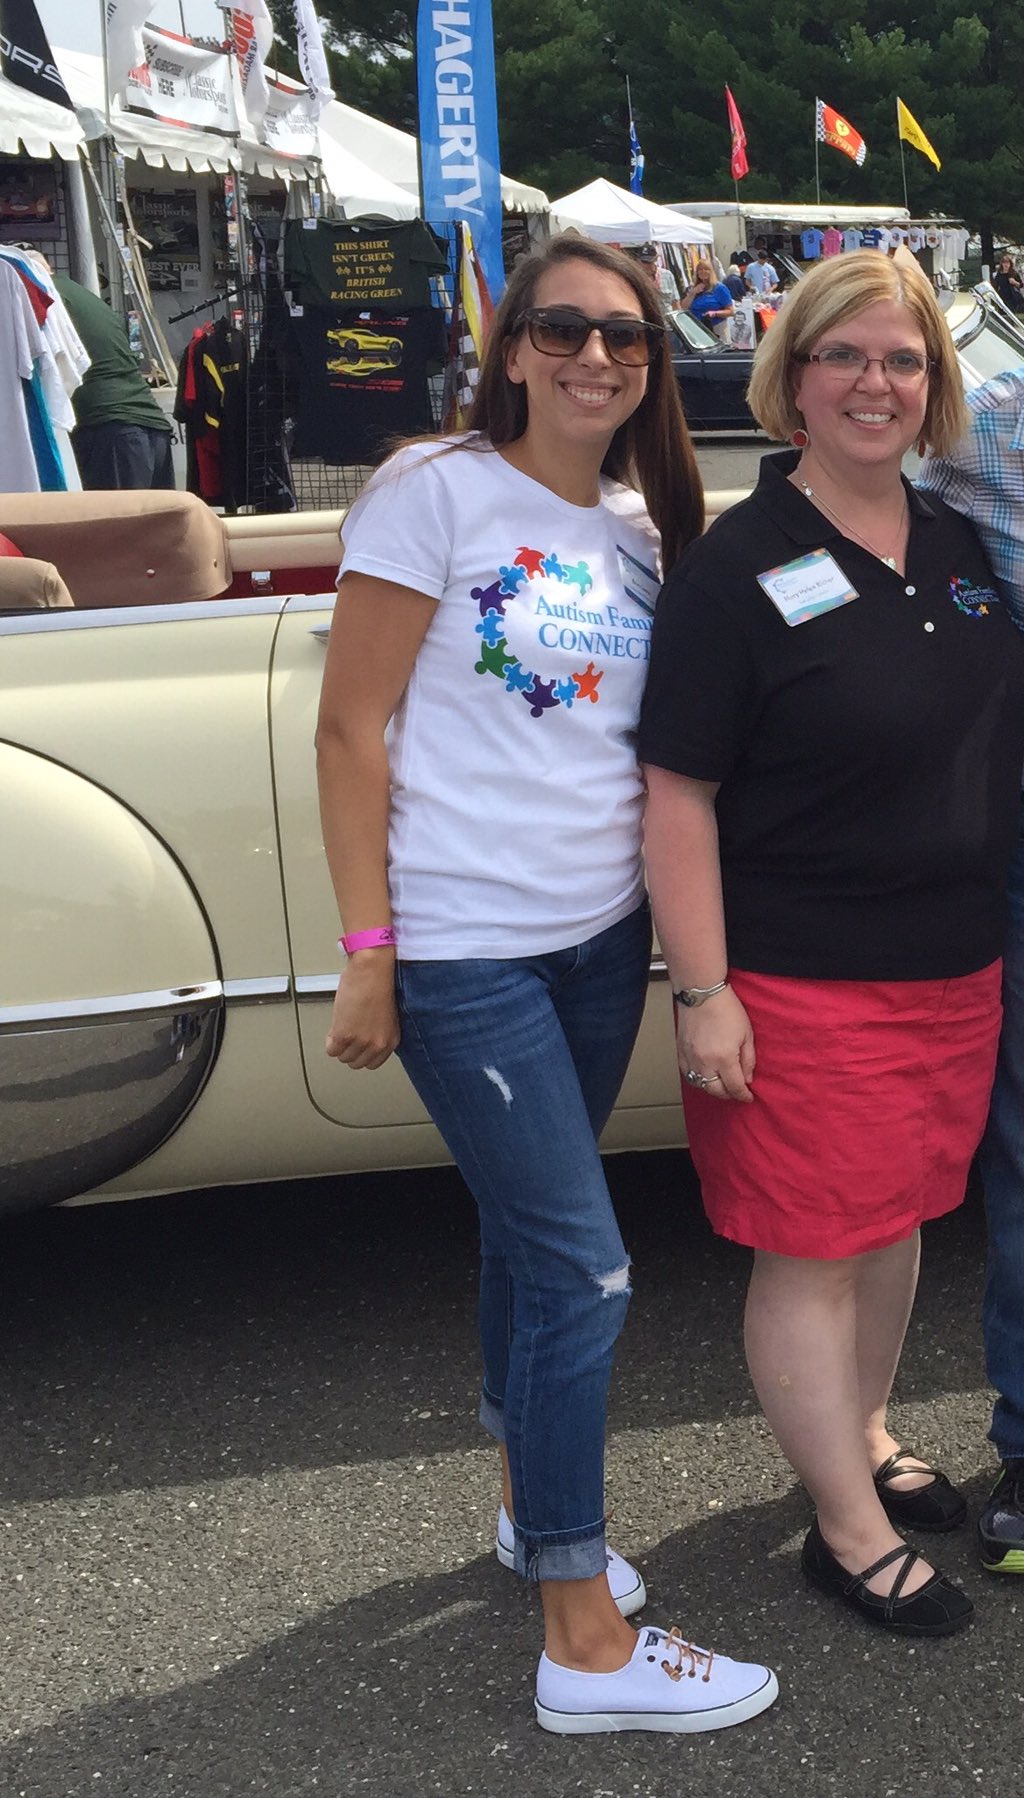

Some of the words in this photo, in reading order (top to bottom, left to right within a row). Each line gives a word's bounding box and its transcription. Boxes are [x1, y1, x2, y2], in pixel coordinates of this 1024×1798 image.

[430, 0, 484, 217] HAGERTY
[334, 241, 358, 251] THIS
[359, 240, 390, 250] SHIRT
[332, 254, 358, 263] ISN'T
[360, 252, 395, 262] GREEN
[173, 263, 200, 272] EVER
[355, 265, 375, 274] IT'S
[346, 277, 386, 287] BRITISH
[330, 290, 369, 299] RACING
[370, 288, 403, 298] GREEN
[534, 595, 605, 626] Autism
[538, 622, 652, 661] CONNECT
